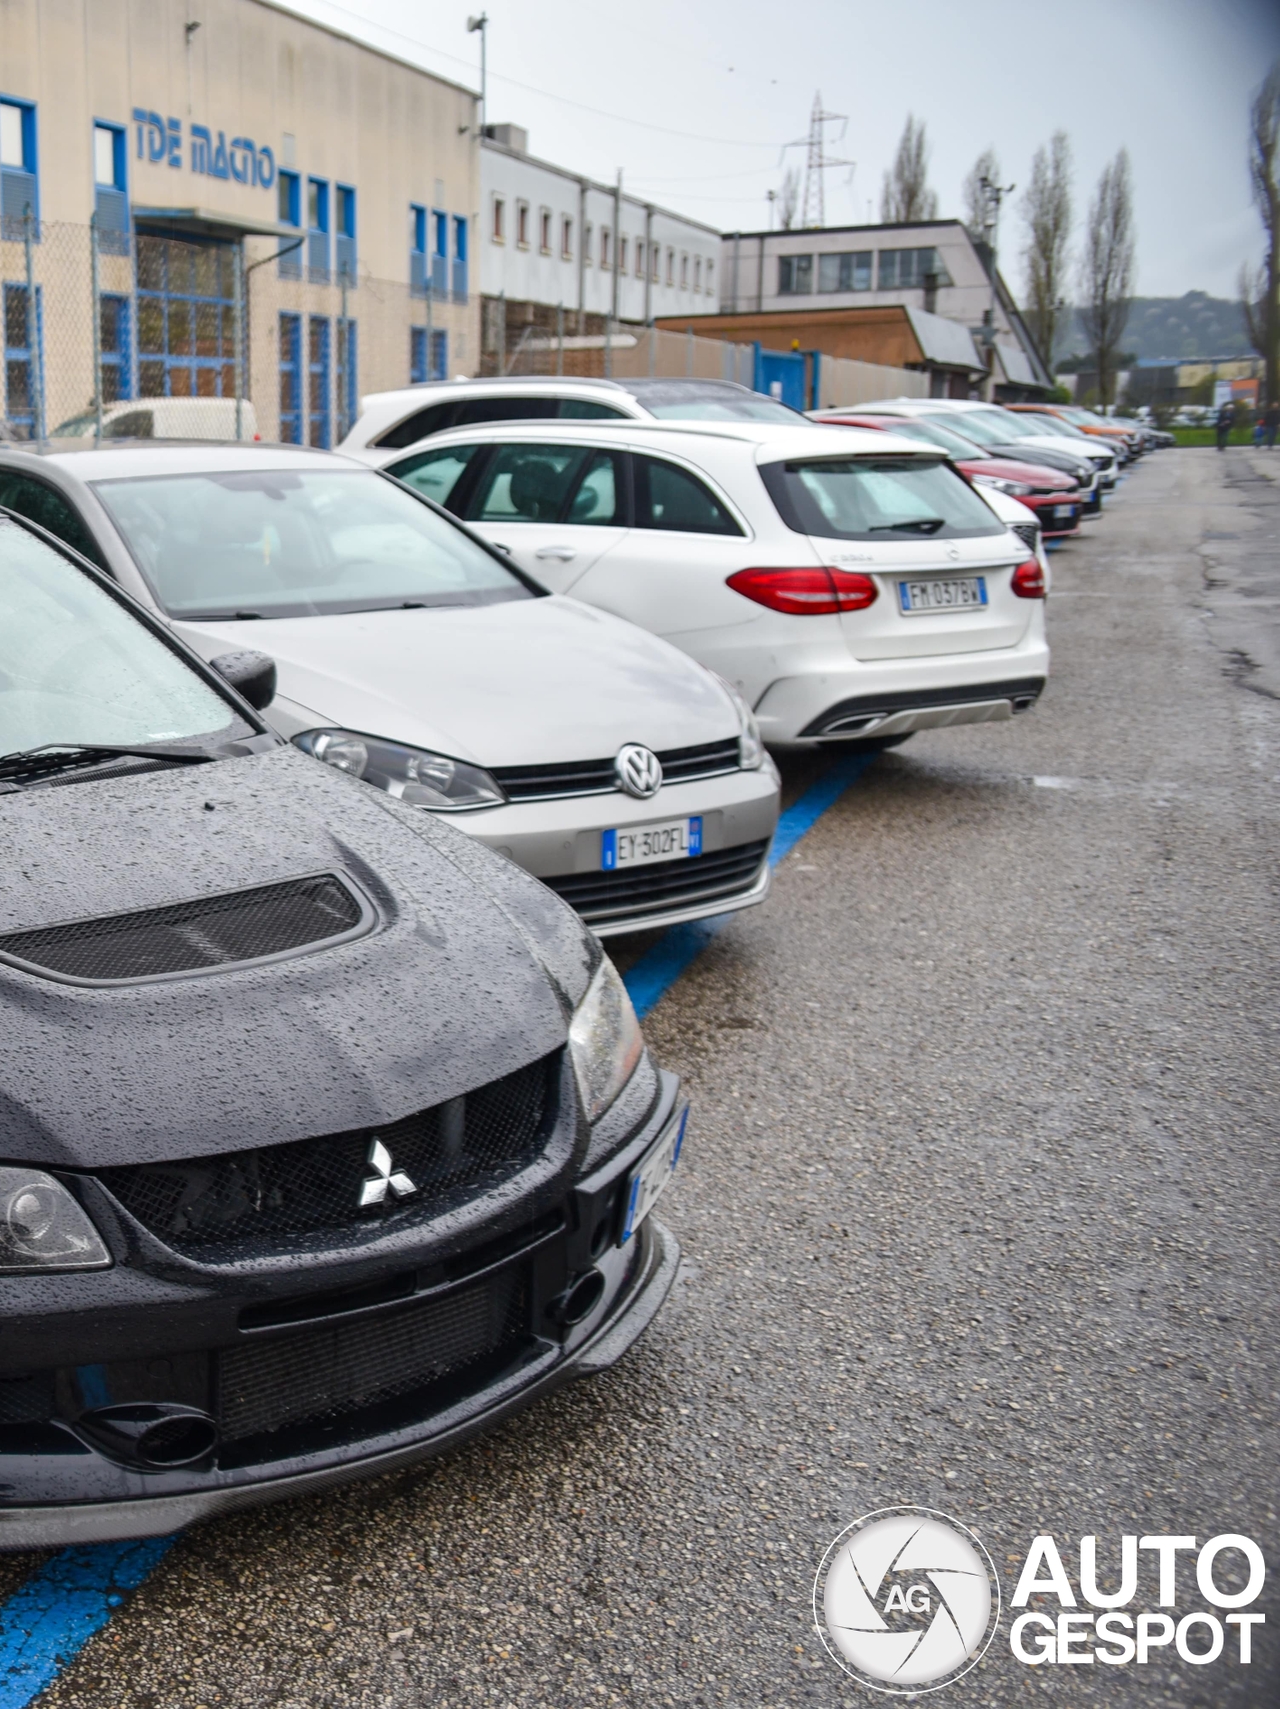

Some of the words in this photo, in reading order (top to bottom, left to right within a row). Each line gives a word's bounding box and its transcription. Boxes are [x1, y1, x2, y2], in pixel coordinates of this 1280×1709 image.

[132, 107, 182, 168] TDE
[618, 834, 637, 860] EY
[642, 827, 689, 857] 302FL
